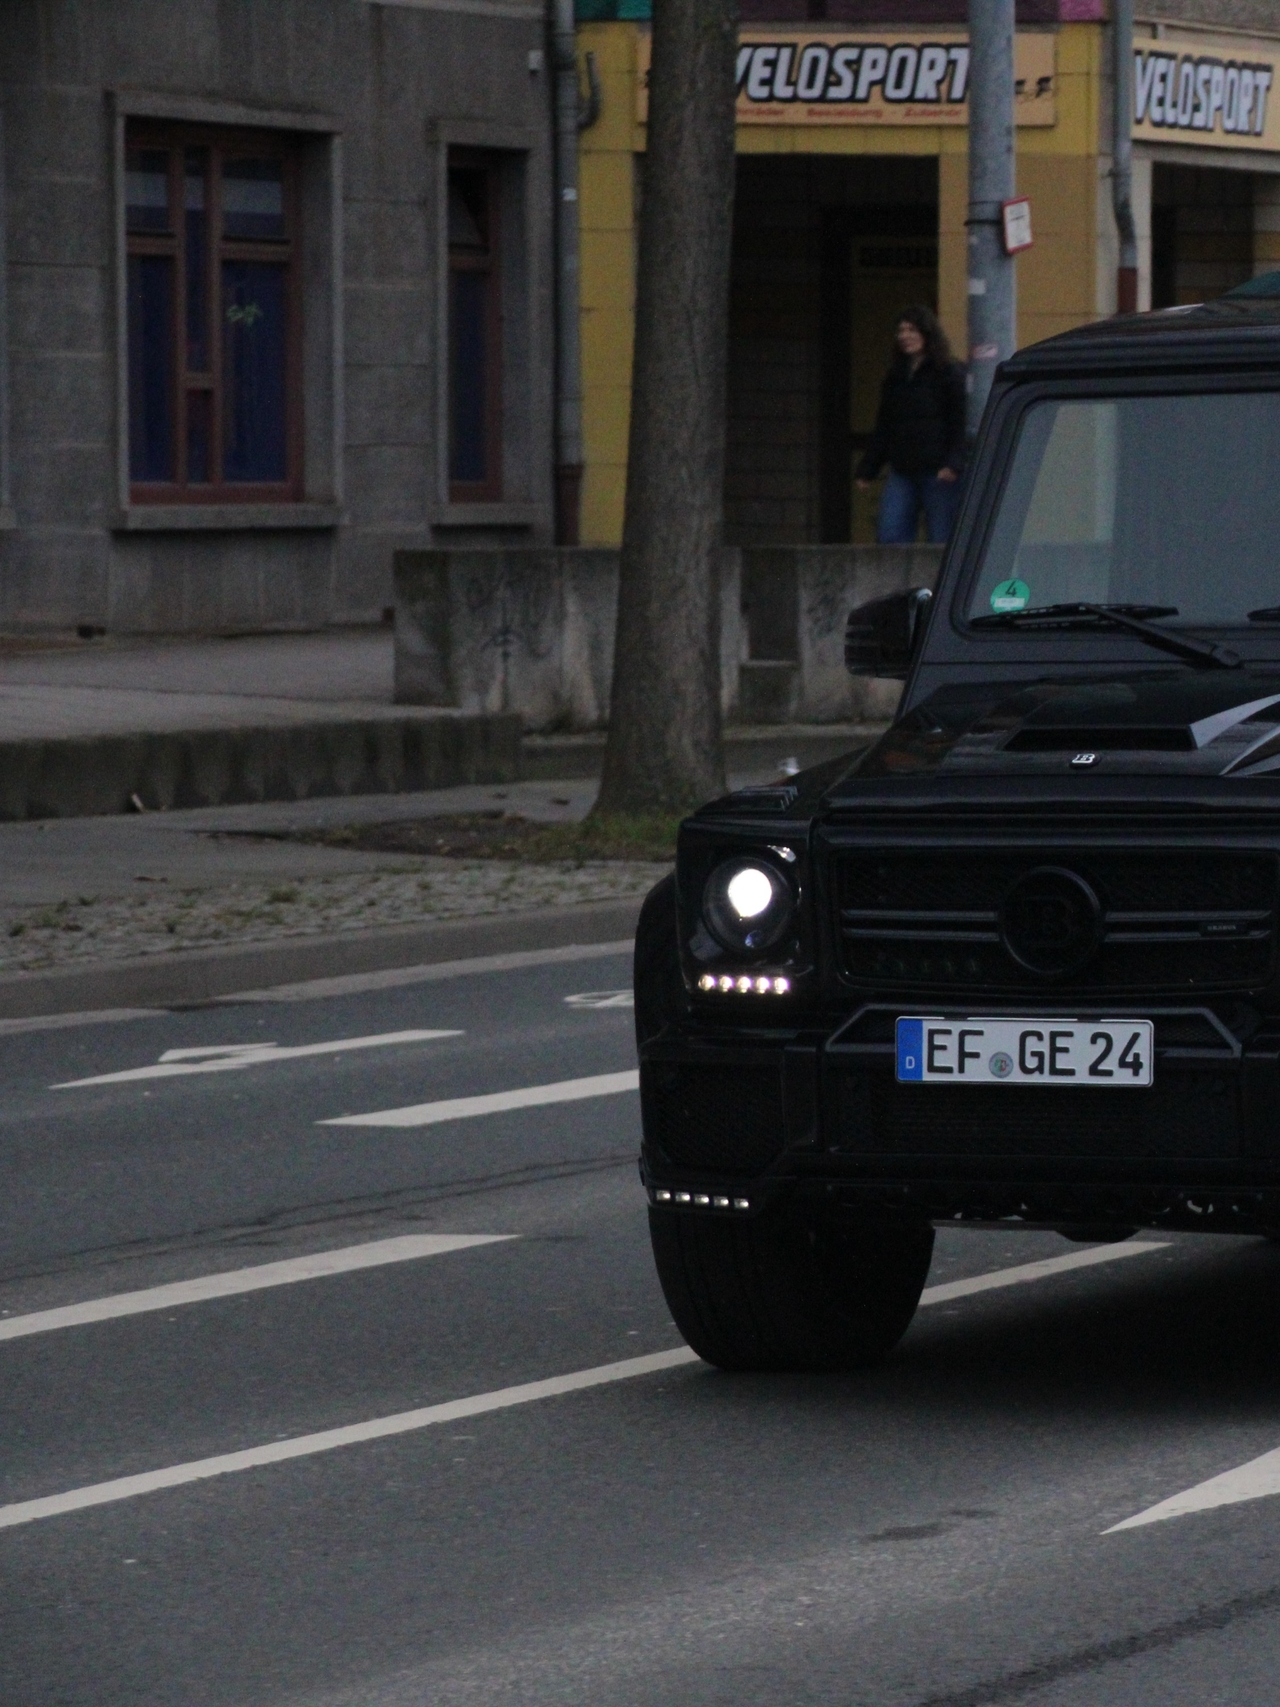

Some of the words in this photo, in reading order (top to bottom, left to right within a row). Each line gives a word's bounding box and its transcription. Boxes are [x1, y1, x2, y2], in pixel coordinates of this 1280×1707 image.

[1134, 50, 1273, 137] VELOSPORT
[1006, 580, 1017, 597] 4
[905, 1056, 916, 1069] D
[927, 1028, 985, 1074] EF
[1018, 1030, 1077, 1077] GE
[1088, 1031, 1144, 1077] 24
